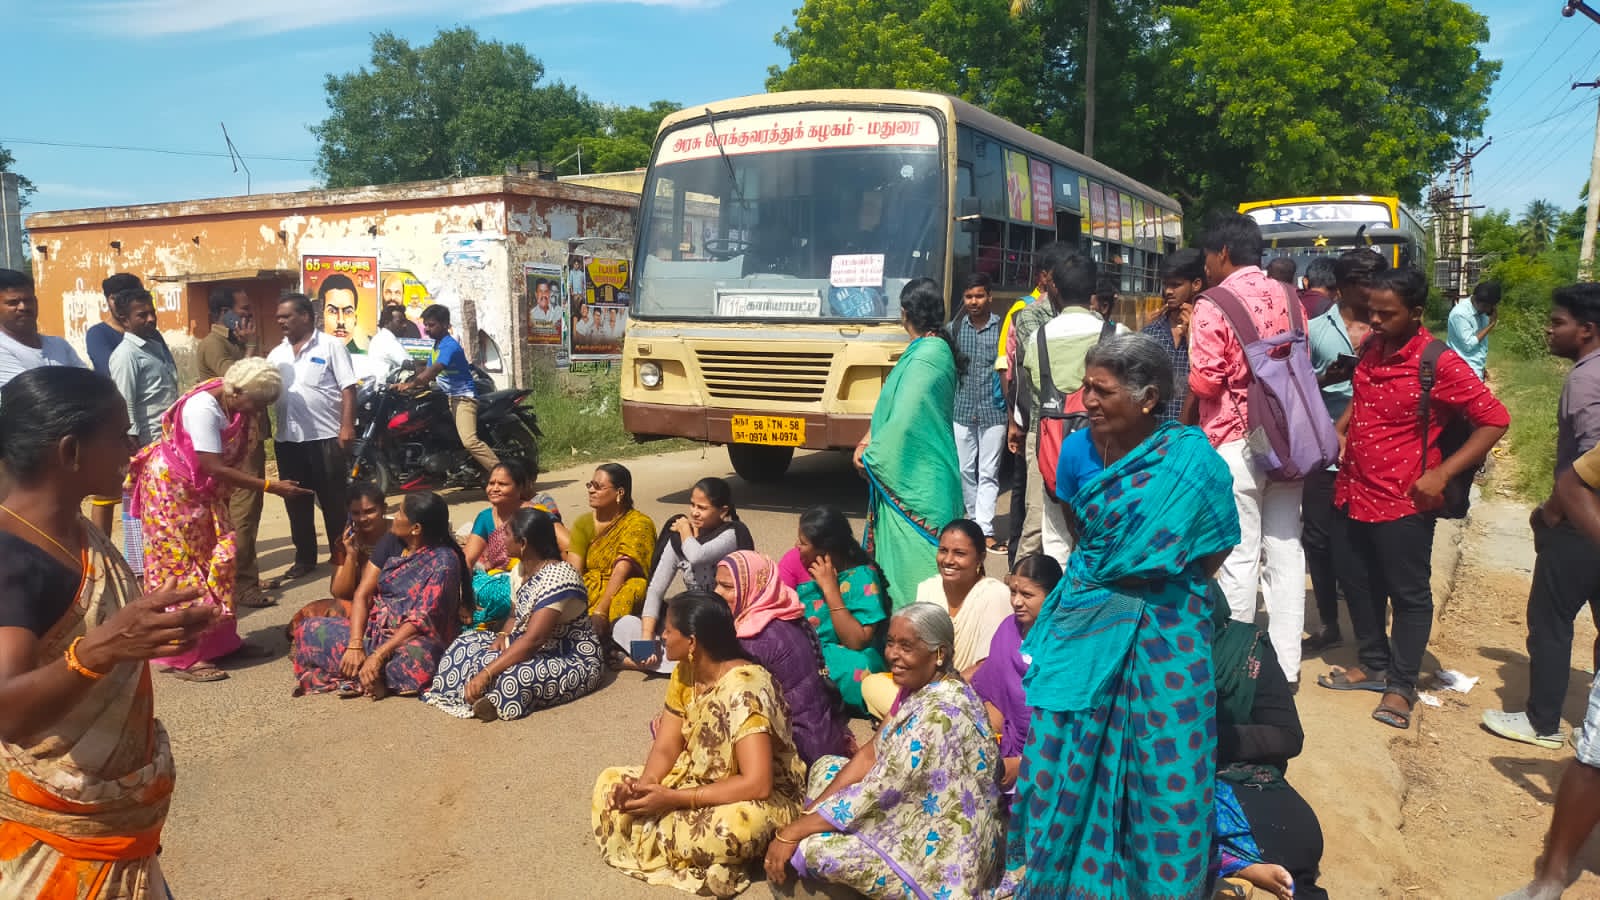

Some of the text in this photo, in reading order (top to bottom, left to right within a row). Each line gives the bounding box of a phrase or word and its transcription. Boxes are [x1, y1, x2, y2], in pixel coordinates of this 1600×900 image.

[673, 137, 702, 152] அரசு
[808, 117, 854, 142] கழகம்
[867, 121, 920, 139] மதுரை
[305, 259, 320, 271] 65
[754, 420, 764, 430] 58
[772, 420, 783, 429] TN
[789, 421, 799, 430] 58
